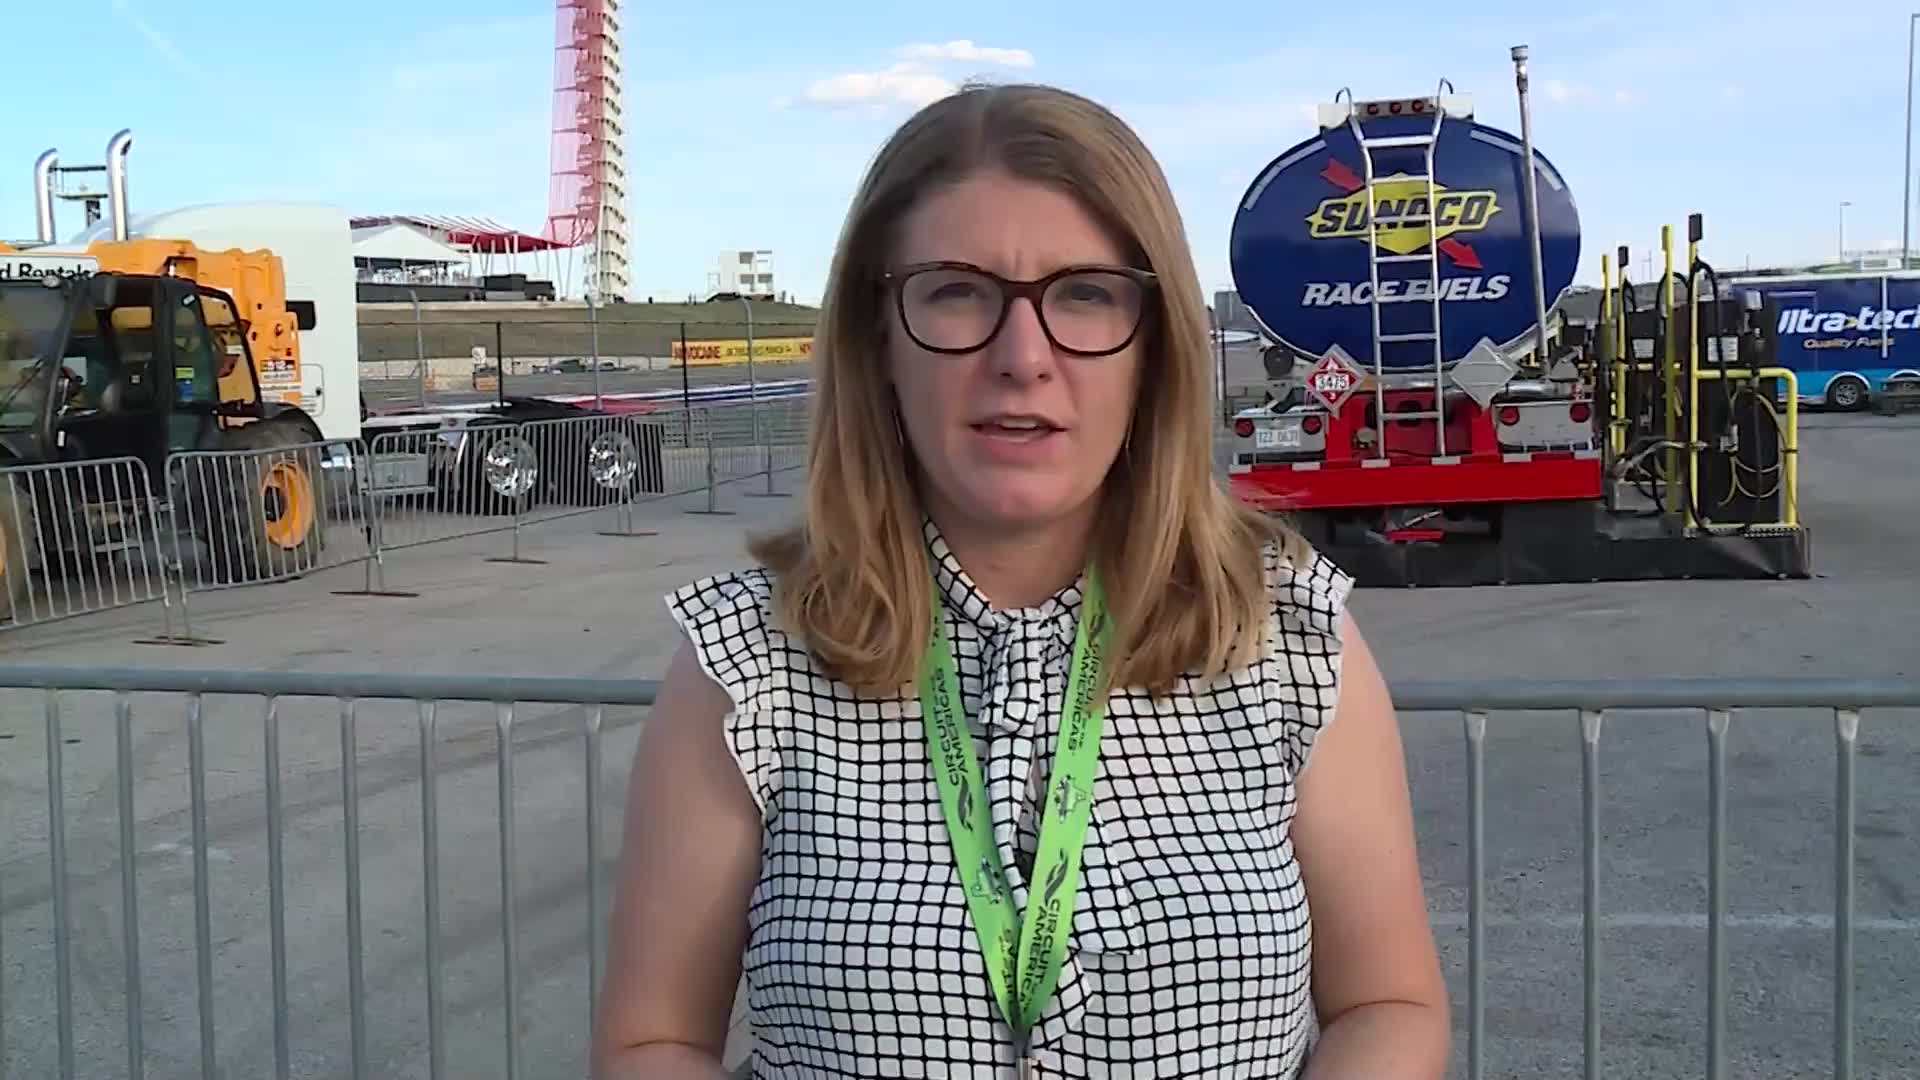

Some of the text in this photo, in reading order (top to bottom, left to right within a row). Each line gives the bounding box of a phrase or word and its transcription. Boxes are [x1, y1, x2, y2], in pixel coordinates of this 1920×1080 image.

[1317, 196, 1491, 233] SUNOCO
[1301, 275, 1511, 306] RACE FUELS
[936, 667, 969, 774] AMERICAS
[1068, 648, 1089, 752] AMERICAS
[932, 706, 959, 787] CIRCUIT
[1035, 898, 1061, 985] CIRCUIT
